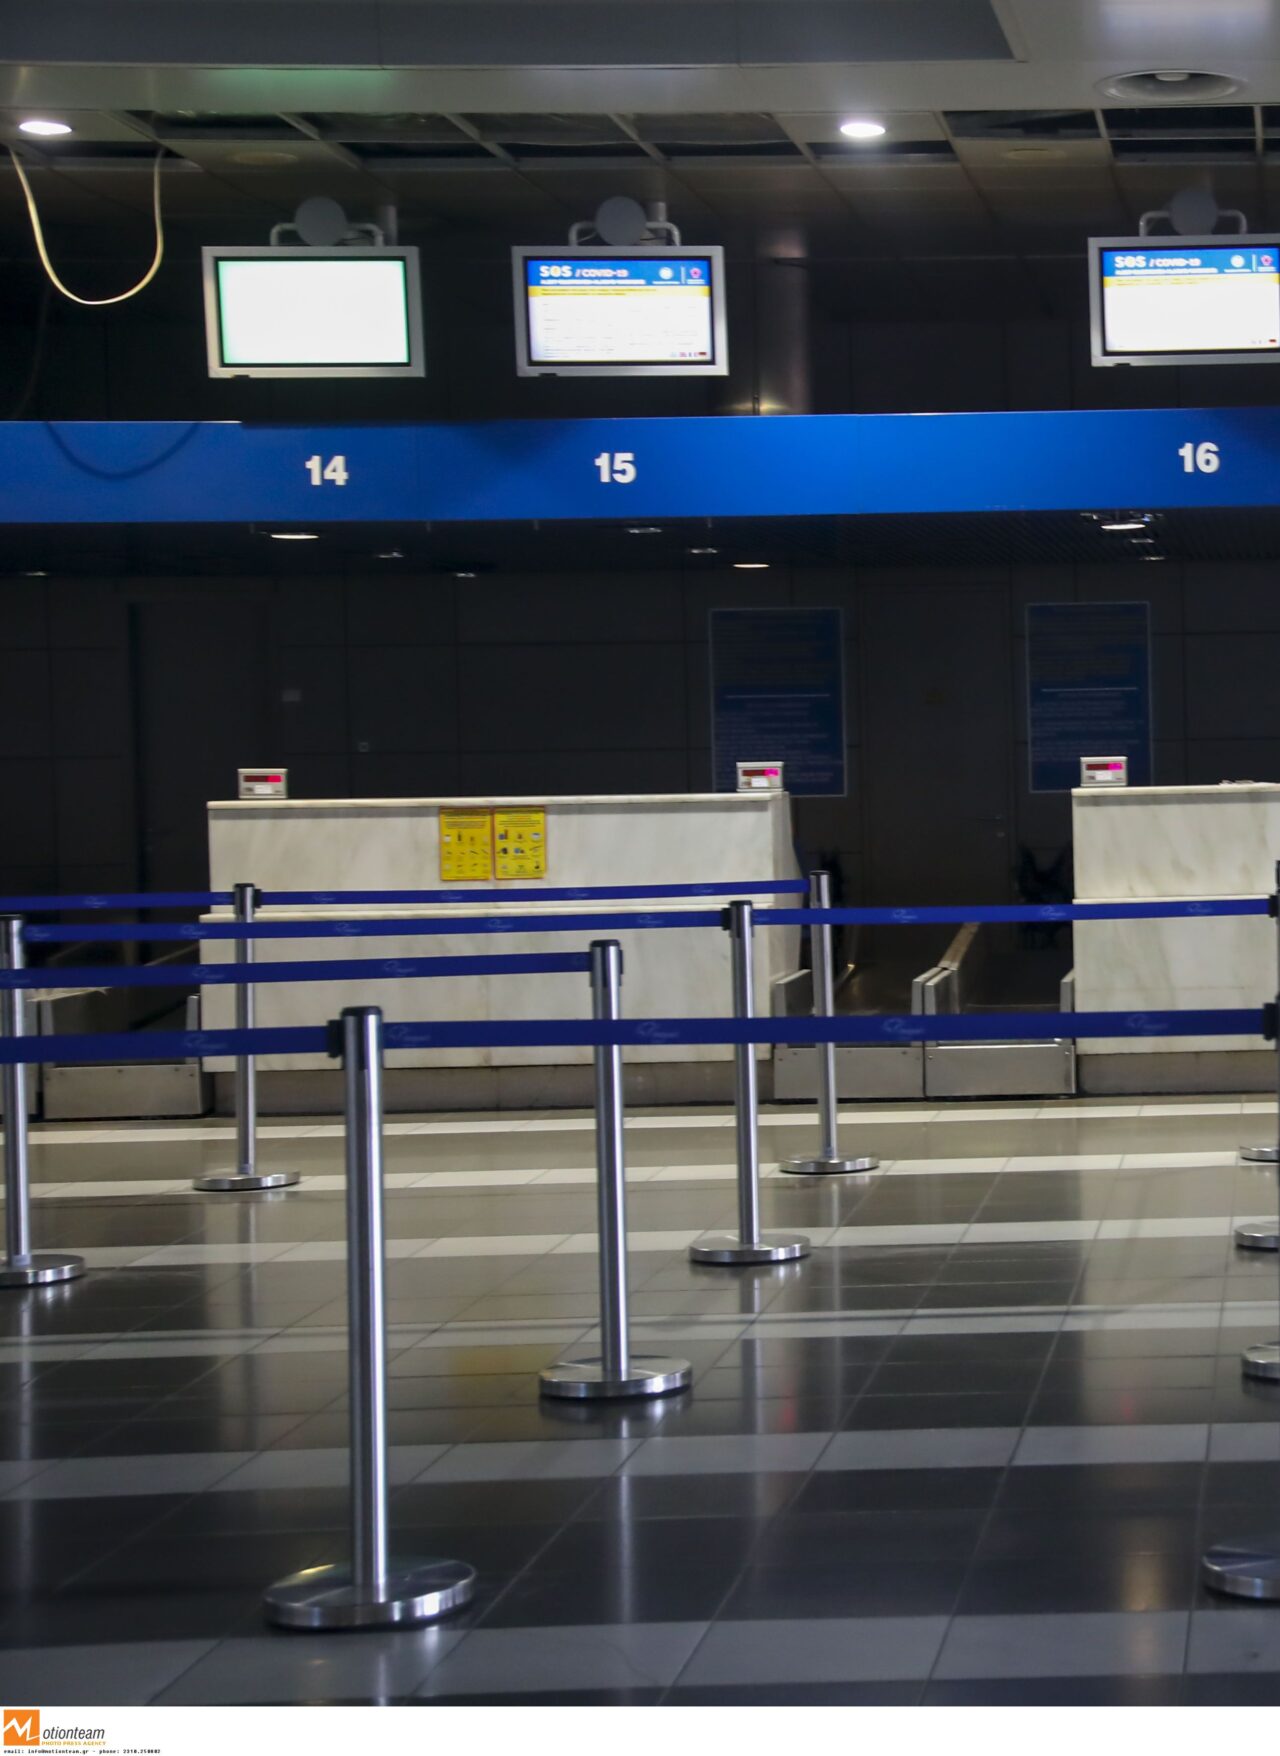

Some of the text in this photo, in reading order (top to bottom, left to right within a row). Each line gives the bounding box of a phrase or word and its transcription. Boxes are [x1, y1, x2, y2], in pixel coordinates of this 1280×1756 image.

[540, 266, 572, 277] SOS
[1115, 256, 1146, 268] SOS
[306, 456, 348, 485] 14
[595, 453, 636, 483] 15
[1179, 442, 1220, 473] 16
